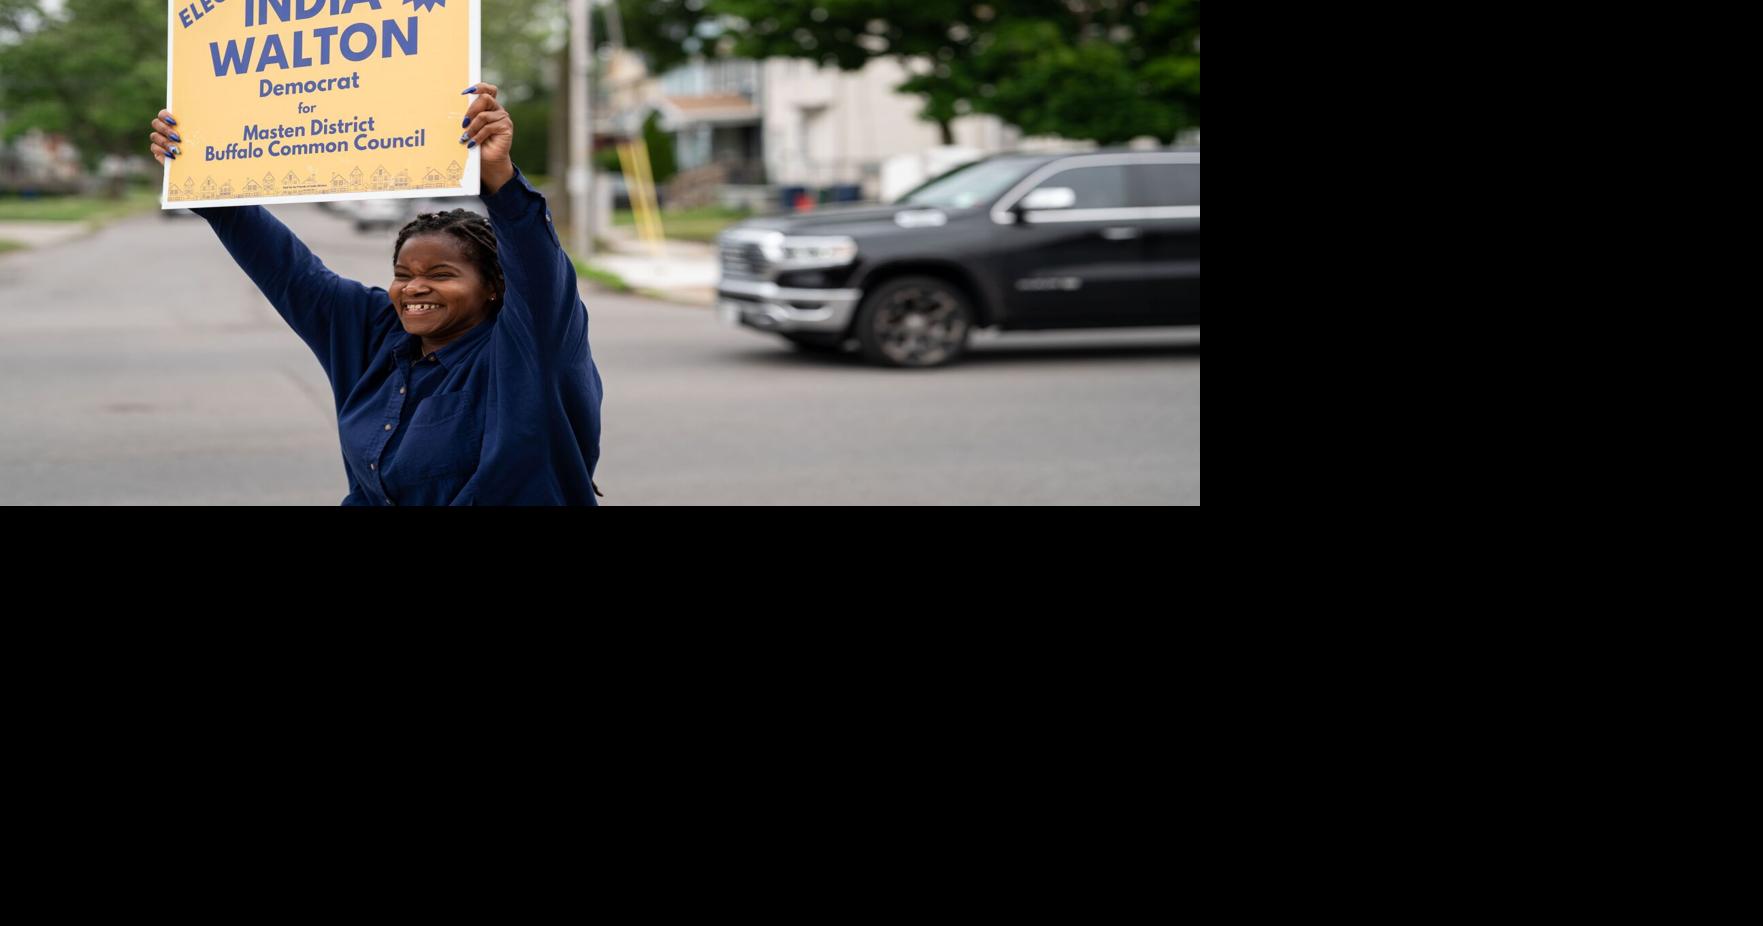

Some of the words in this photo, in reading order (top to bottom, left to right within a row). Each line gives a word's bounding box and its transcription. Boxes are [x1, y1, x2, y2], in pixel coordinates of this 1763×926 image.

[178, 0, 224, 29] ELE
[209, 15, 419, 78] WALTON
[259, 71, 360, 98] Democrat
[297, 102, 317, 114] for
[242, 124, 306, 141] Masten
[310, 116, 375, 137] District
[204, 142, 264, 162] Buffalo
[267, 139, 349, 158] Common
[353, 128, 426, 152] Council
